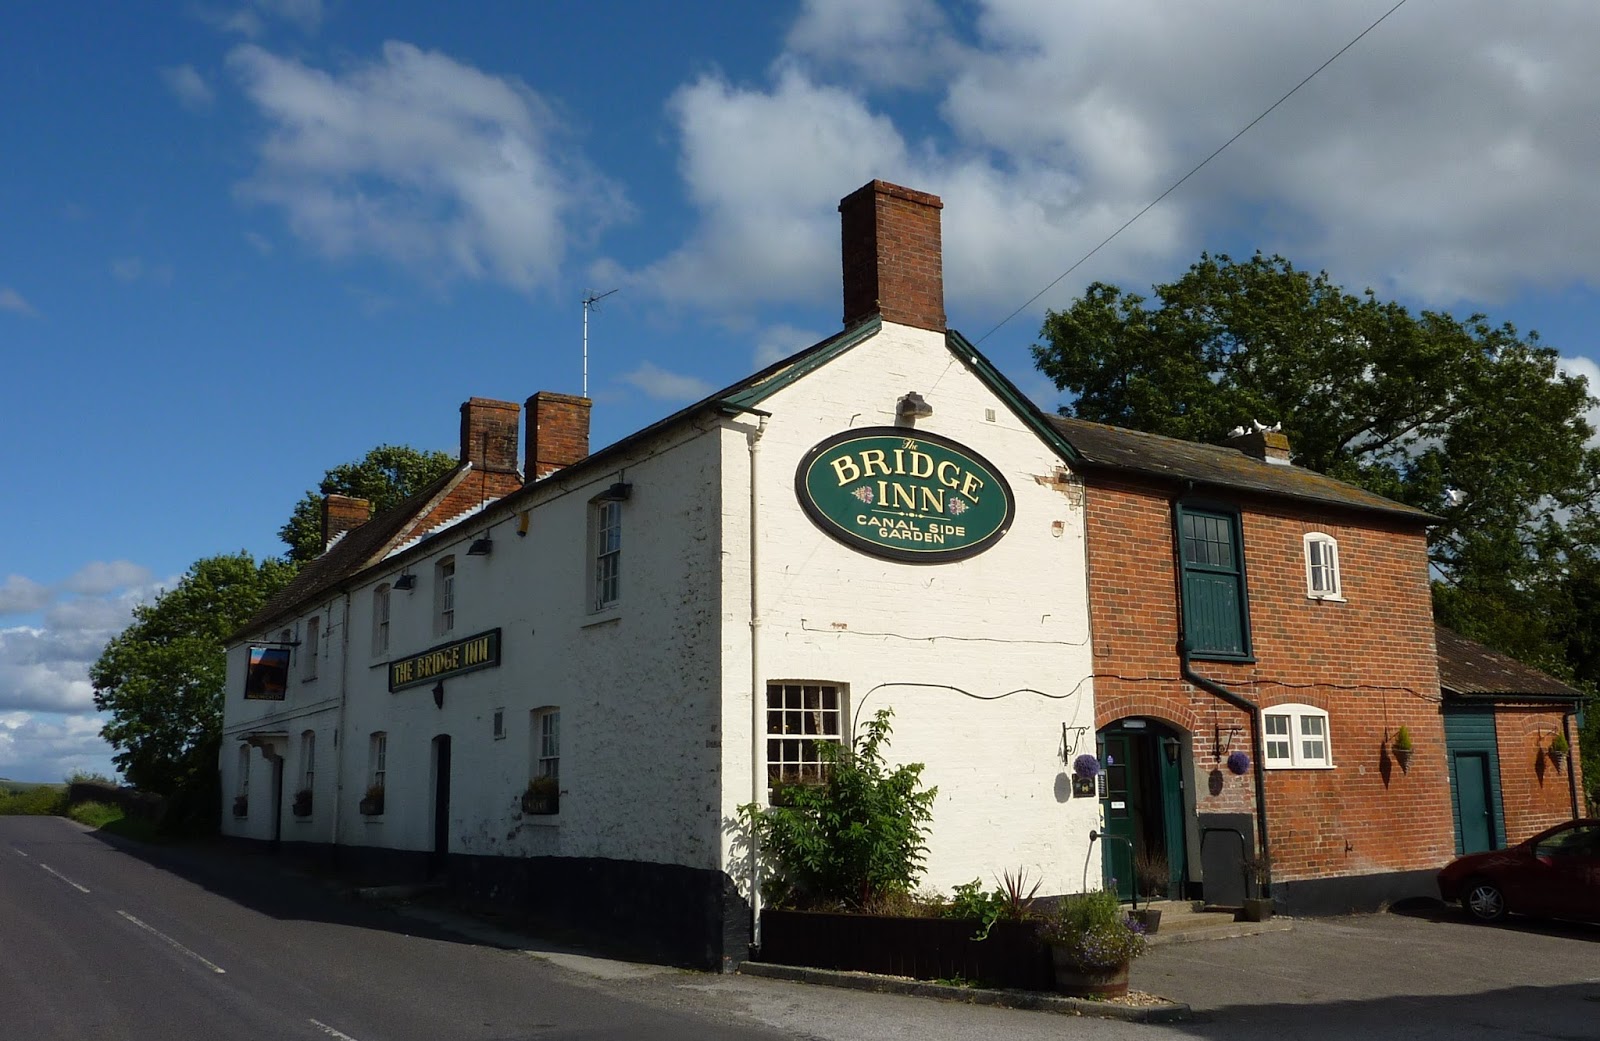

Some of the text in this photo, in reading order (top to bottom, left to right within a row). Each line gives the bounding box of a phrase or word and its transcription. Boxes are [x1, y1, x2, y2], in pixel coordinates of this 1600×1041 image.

[902, 438, 918, 451] The
[830, 449, 984, 503] BRIDGE
[877, 480, 945, 513] INN
[856, 514, 965, 537] CANAL SIDE
[878, 528, 944, 544] GARDEN
[394, 638, 488, 684] THE BRIDGE INN
